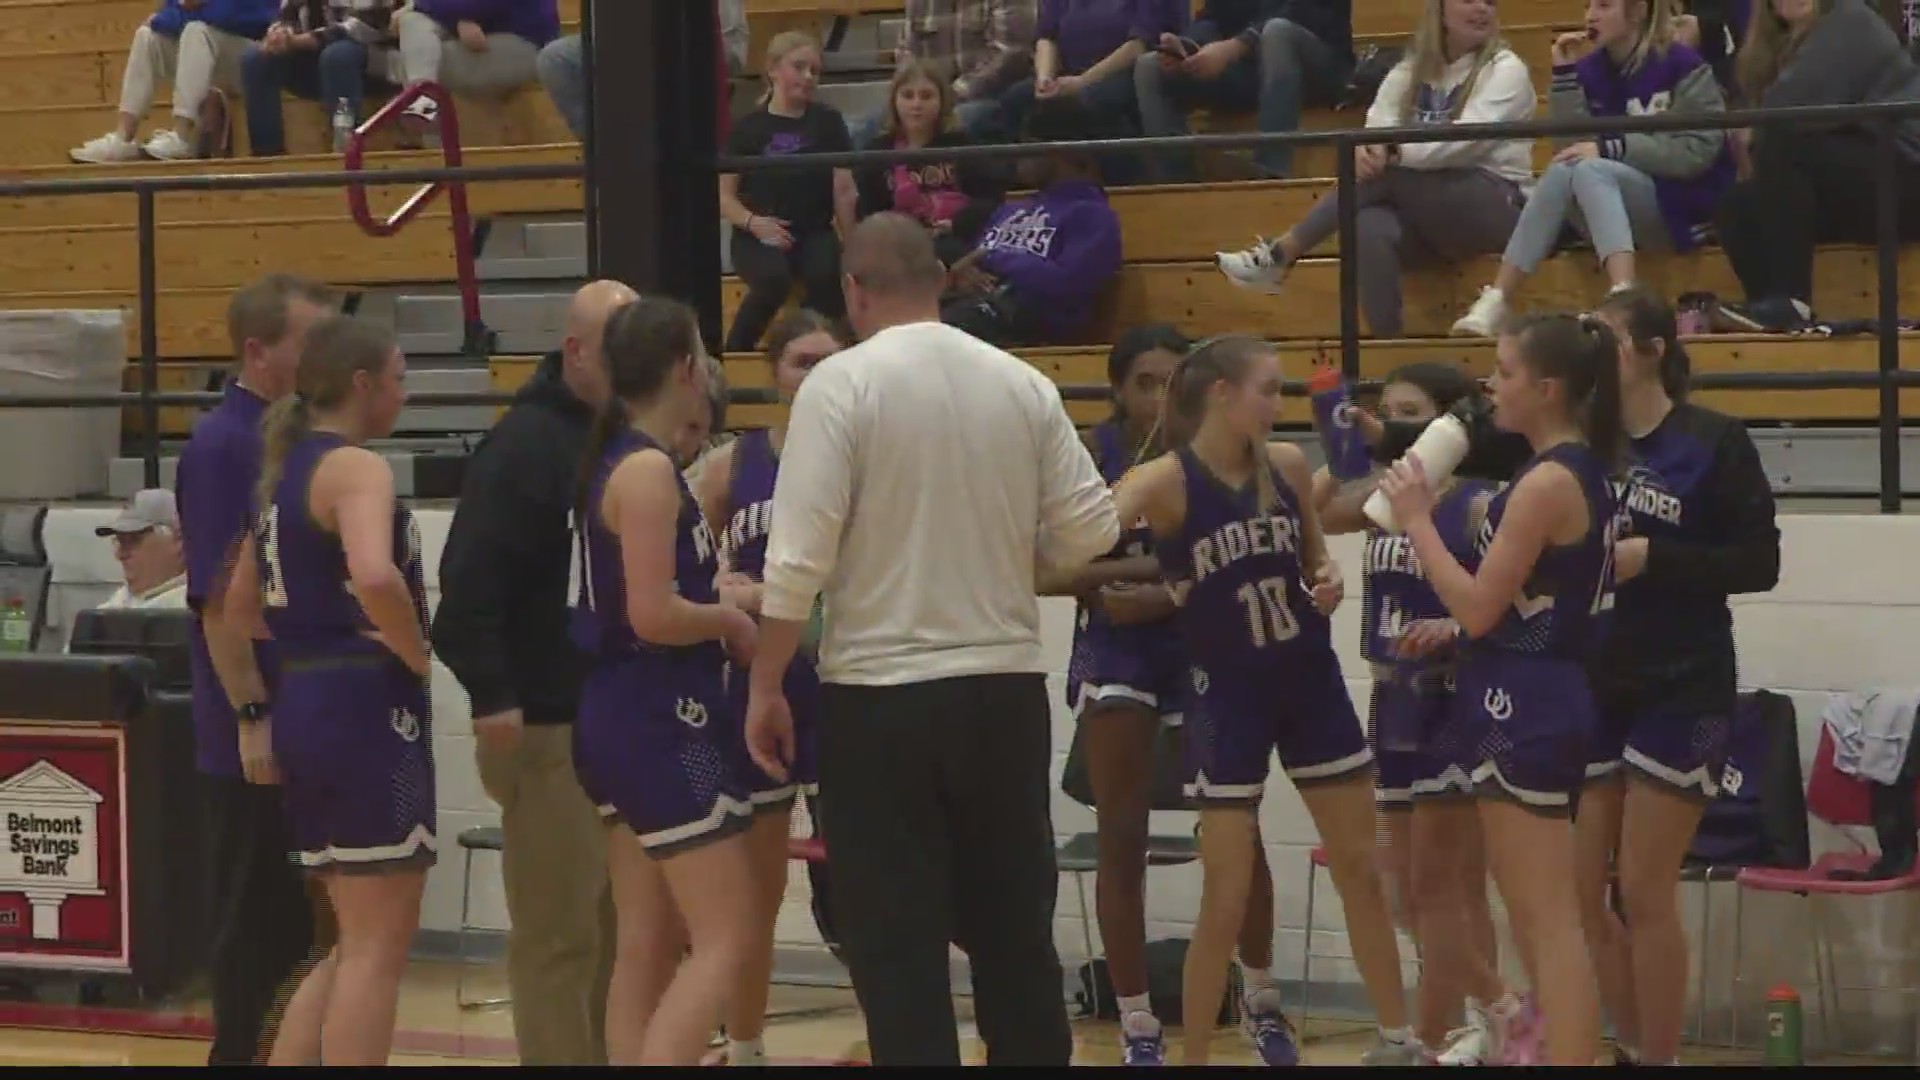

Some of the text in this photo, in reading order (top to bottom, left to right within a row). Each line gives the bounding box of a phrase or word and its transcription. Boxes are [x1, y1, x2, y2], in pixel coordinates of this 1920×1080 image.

[1234, 576, 1300, 647] 10
[8, 811, 83, 834] Belmont
[10, 832, 80, 860] Savings
[24, 855, 68, 876] Bank
